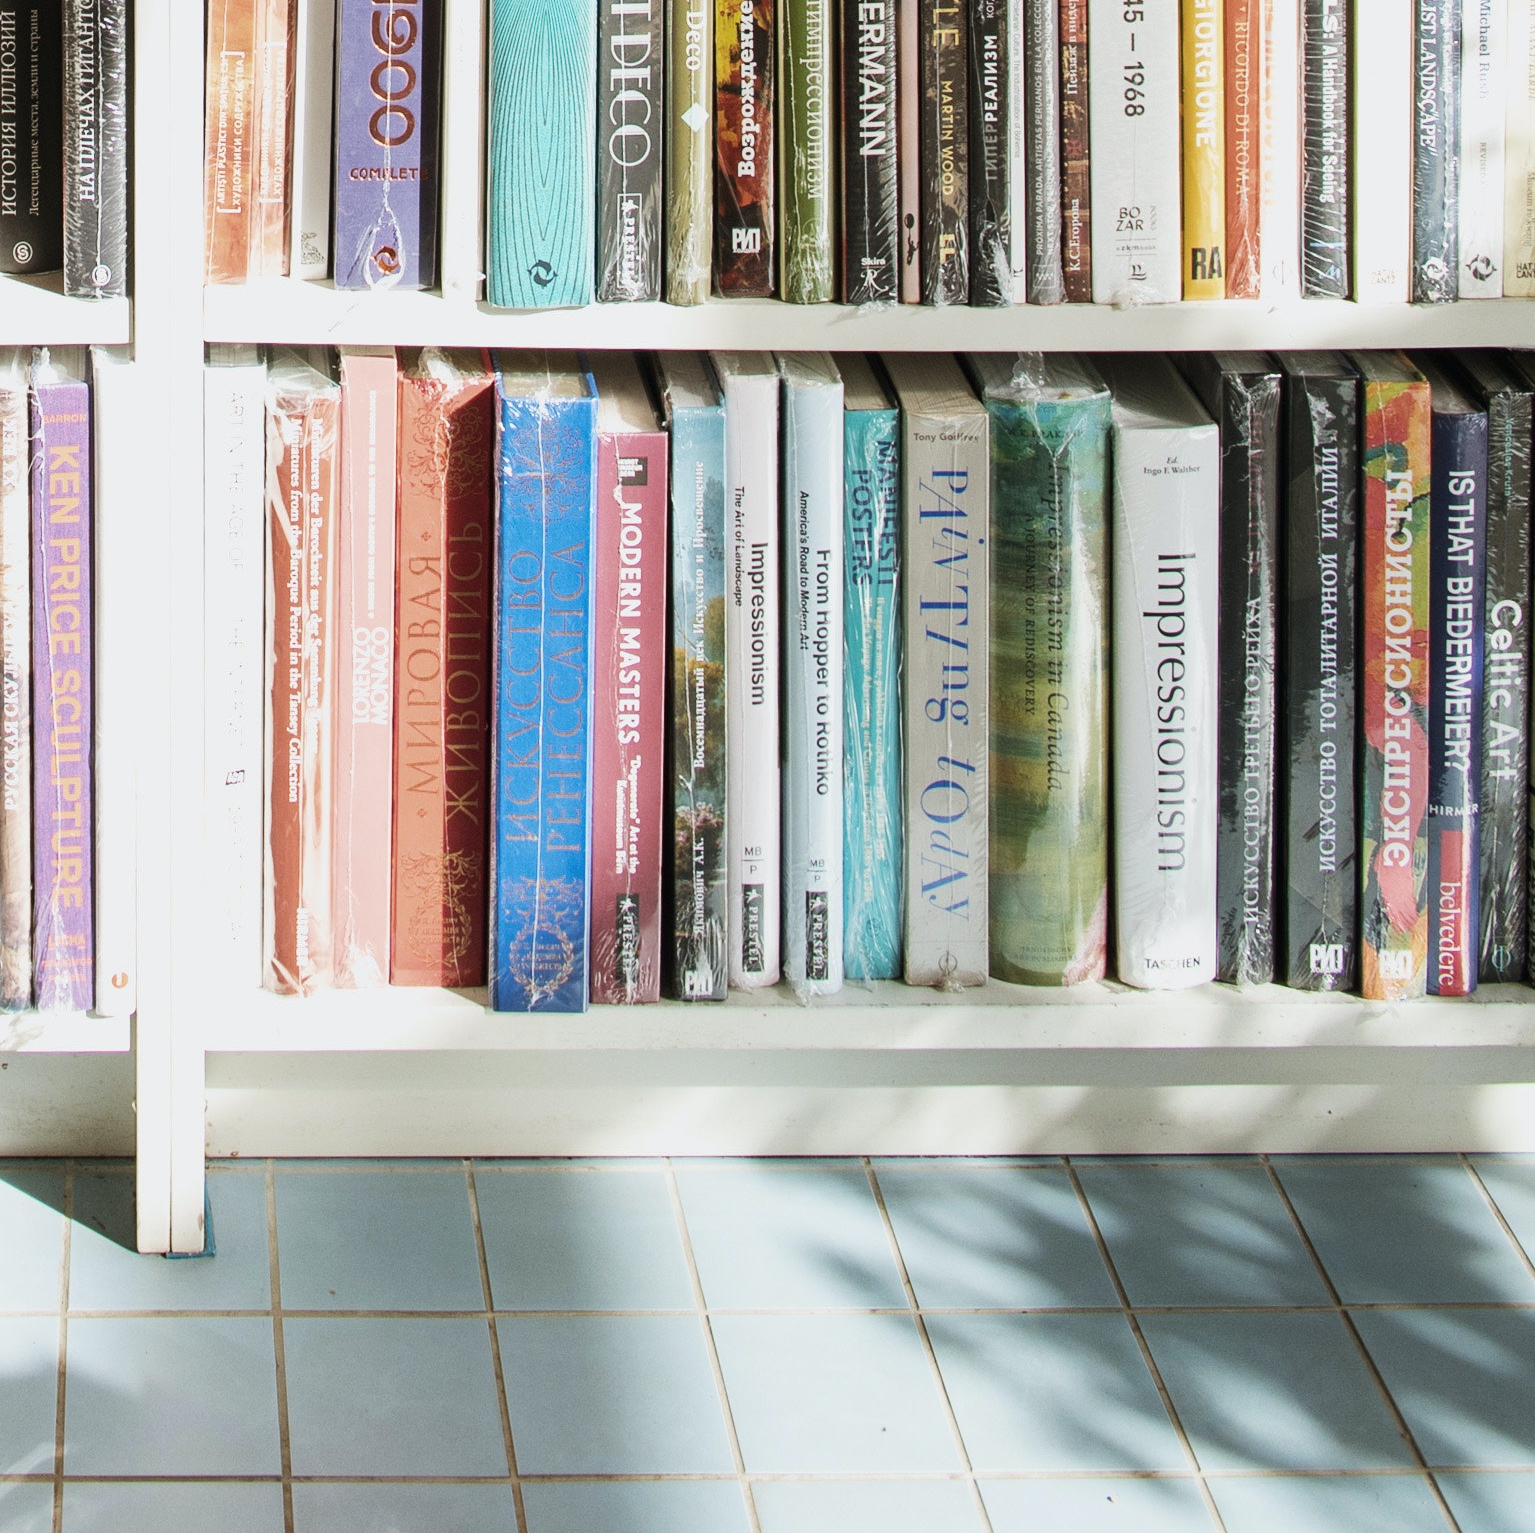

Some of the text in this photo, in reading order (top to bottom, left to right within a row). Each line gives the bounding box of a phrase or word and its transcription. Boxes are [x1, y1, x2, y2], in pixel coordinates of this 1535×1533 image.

[0, 121, 18, 216] ИСТОРИЯ
[609, 35, 652, 167] DECO
[47, 444, 82, 910] KEN PRICE SCULPTURE
[618, 502, 643, 747] MODERN MASTERS
[1142, 552, 1195, 874] Impressionism
[1382, 468, 1413, 868] ЭКСПРЕССИОНИСТЫ
[1442, 469, 1476, 772] IS THAT BIEDERMEIER?
[1489, 599, 1522, 783] Celtic Art
